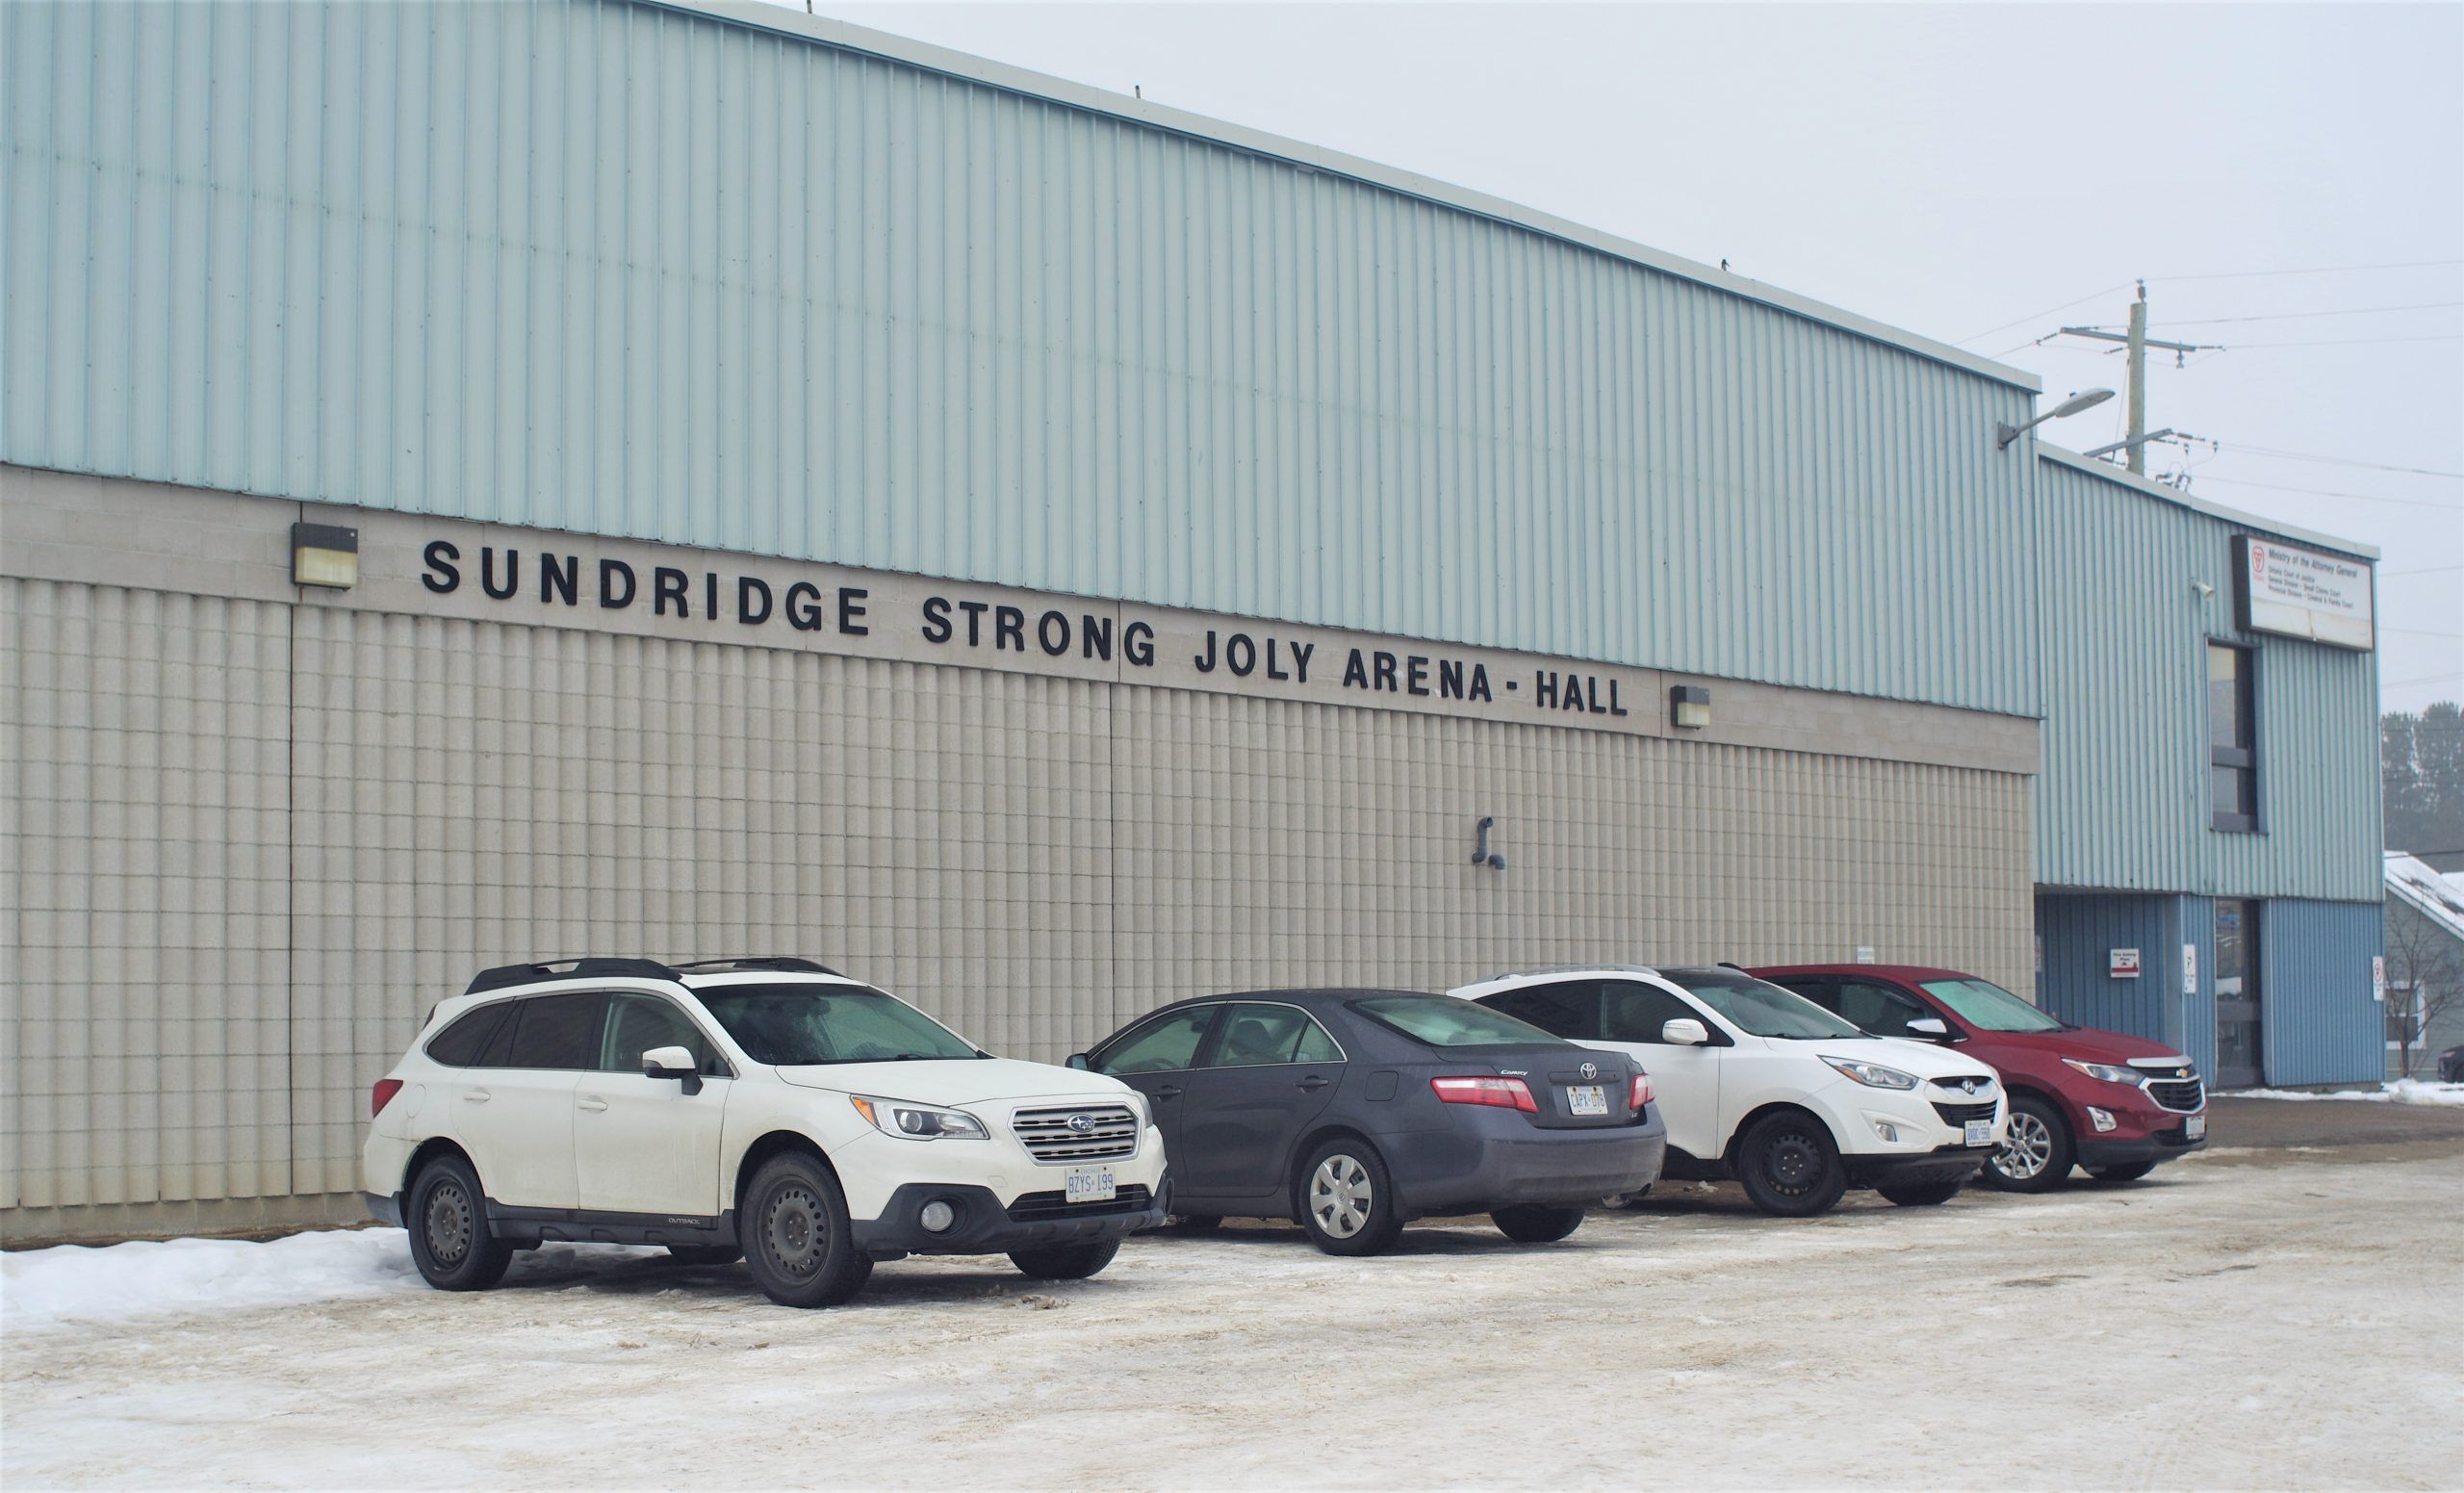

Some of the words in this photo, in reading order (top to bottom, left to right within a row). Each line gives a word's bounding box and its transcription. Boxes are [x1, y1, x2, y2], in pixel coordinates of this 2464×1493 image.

[2269, 548, 2291, 564] Ministry
[2300, 557, 2309, 567] the
[2311, 559, 2334, 575] Attorney
[2336, 565, 2357, 578] General
[422, 540, 869, 636] SUNDRIDGE
[921, 597, 1154, 667] STRONG
[1194, 631, 1315, 683] JOLY
[1343, 648, 1493, 703] ARENA
[1536, 670, 1628, 717] HALL
[1591, 1093, 1605, 1108] 078
[1068, 1175, 1091, 1194] BZYS
[1097, 1173, 1114, 1192] 199
[668, 1217, 701, 1225] OUTBACK
